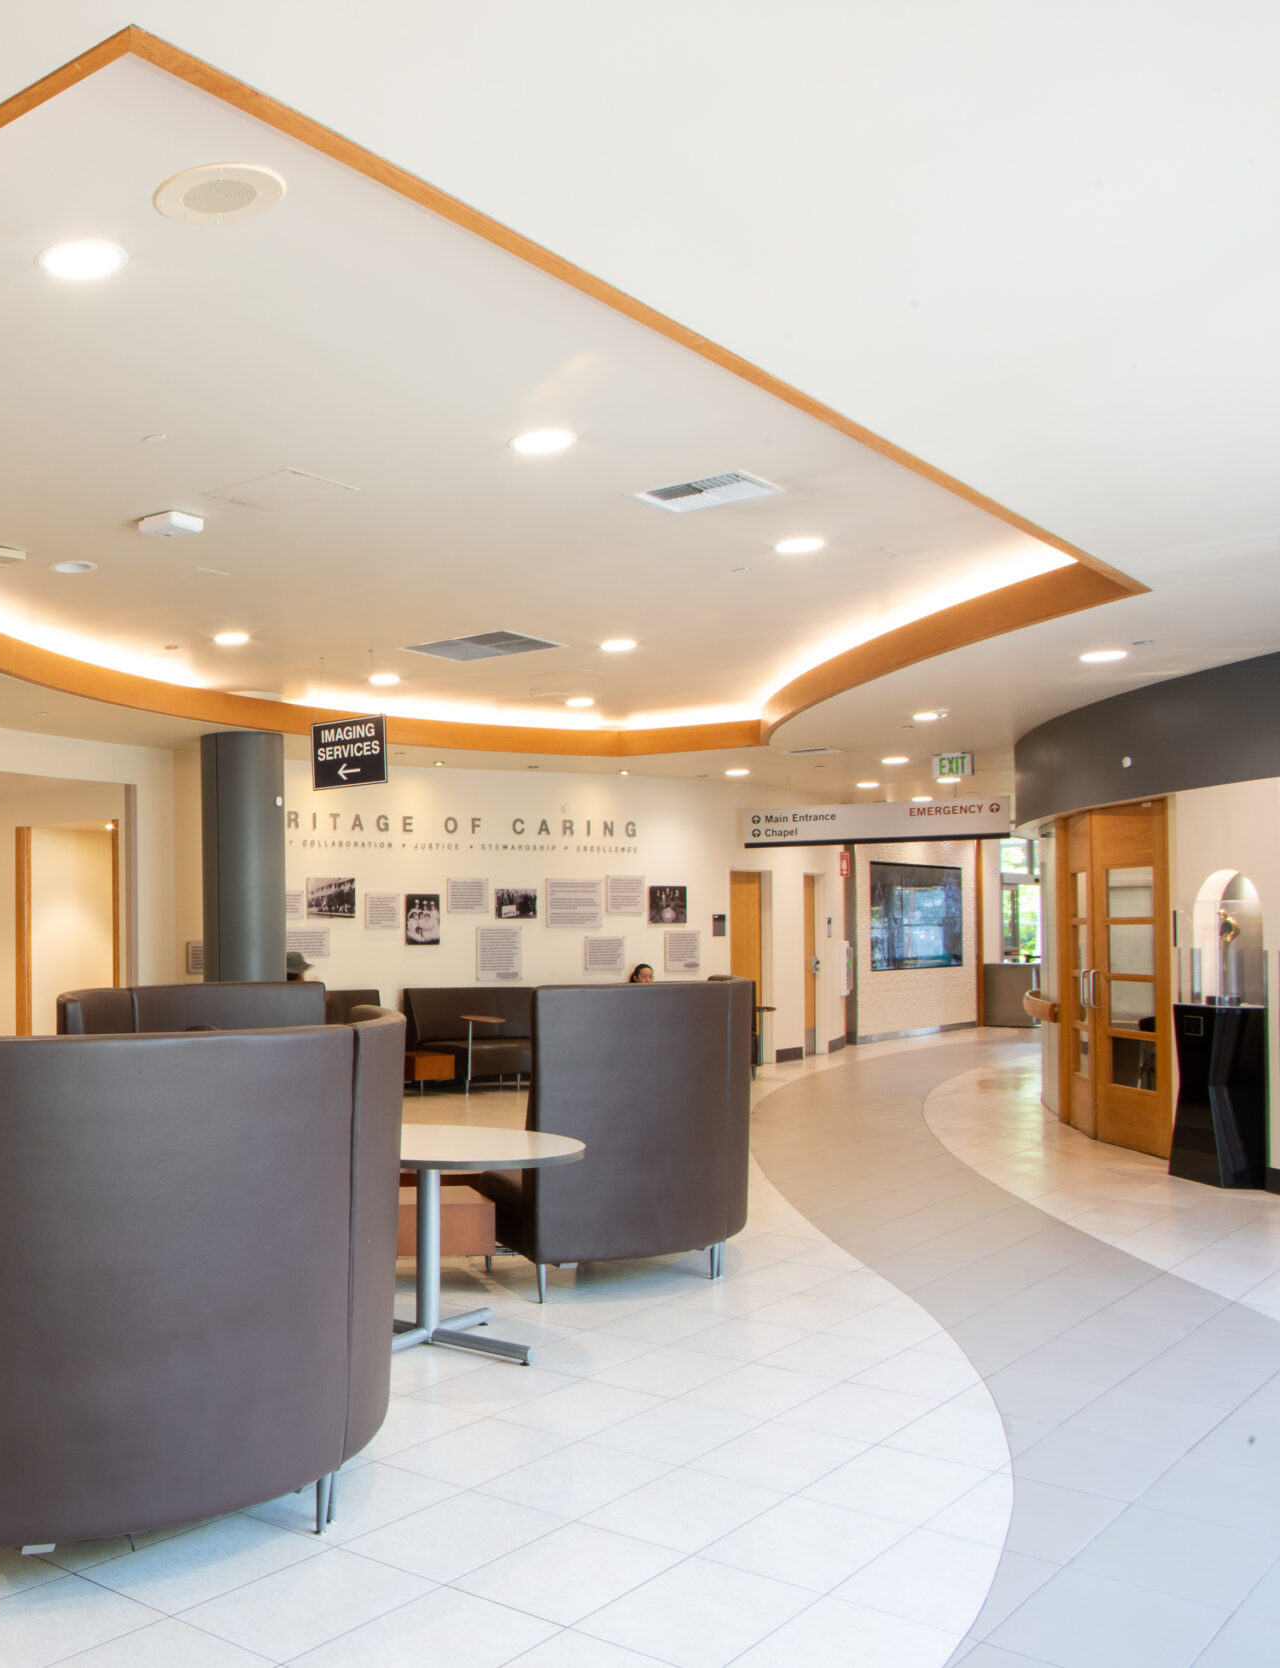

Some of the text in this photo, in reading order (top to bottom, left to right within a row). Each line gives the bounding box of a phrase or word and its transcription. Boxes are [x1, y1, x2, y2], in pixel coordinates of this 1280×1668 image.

[321, 723, 376, 743] IMAGING
[317, 740, 381, 761] SERVICES
[939, 756, 967, 776] EXIT
[764, 812, 837, 824] Main Entrance
[908, 804, 984, 817] EMERGENCY
[444, 817, 482, 834] OF
[512, 818, 637, 838] CARING
[764, 827, 799, 838] Chapel
[302, 840, 393, 849] COLLABORATION
[414, 843, 460, 851] JUSTICE
[481, 843, 558, 852] STEWARDSHIP
[576, 845, 639, 854] EXCELLENCE
